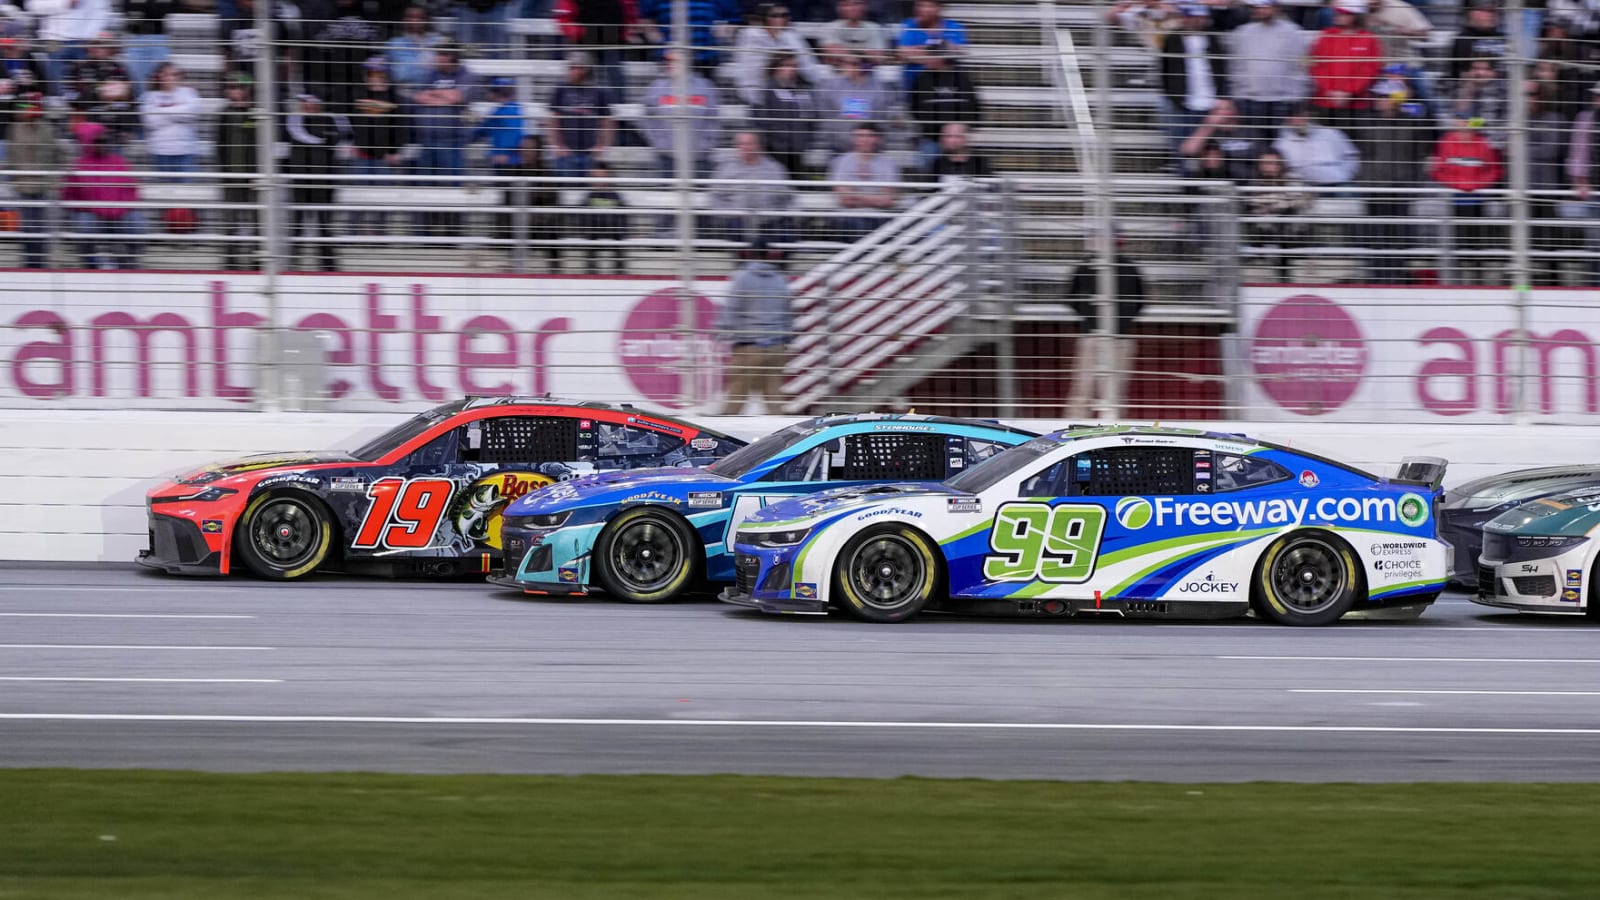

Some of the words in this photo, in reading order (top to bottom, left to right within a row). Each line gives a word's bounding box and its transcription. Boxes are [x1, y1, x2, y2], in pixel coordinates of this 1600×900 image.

[257, 474, 320, 488] GOODYEAR
[621, 491, 682, 505] GOODYEAR
[353, 478, 455, 550] 19
[858, 507, 923, 521] GOODYEAR
[1155, 496, 1397, 526] Freeway.com
[983, 502, 1107, 583] 99
[1385, 560, 1421, 569] CHOICE
[1179, 582, 1239, 592] JOCKEY
